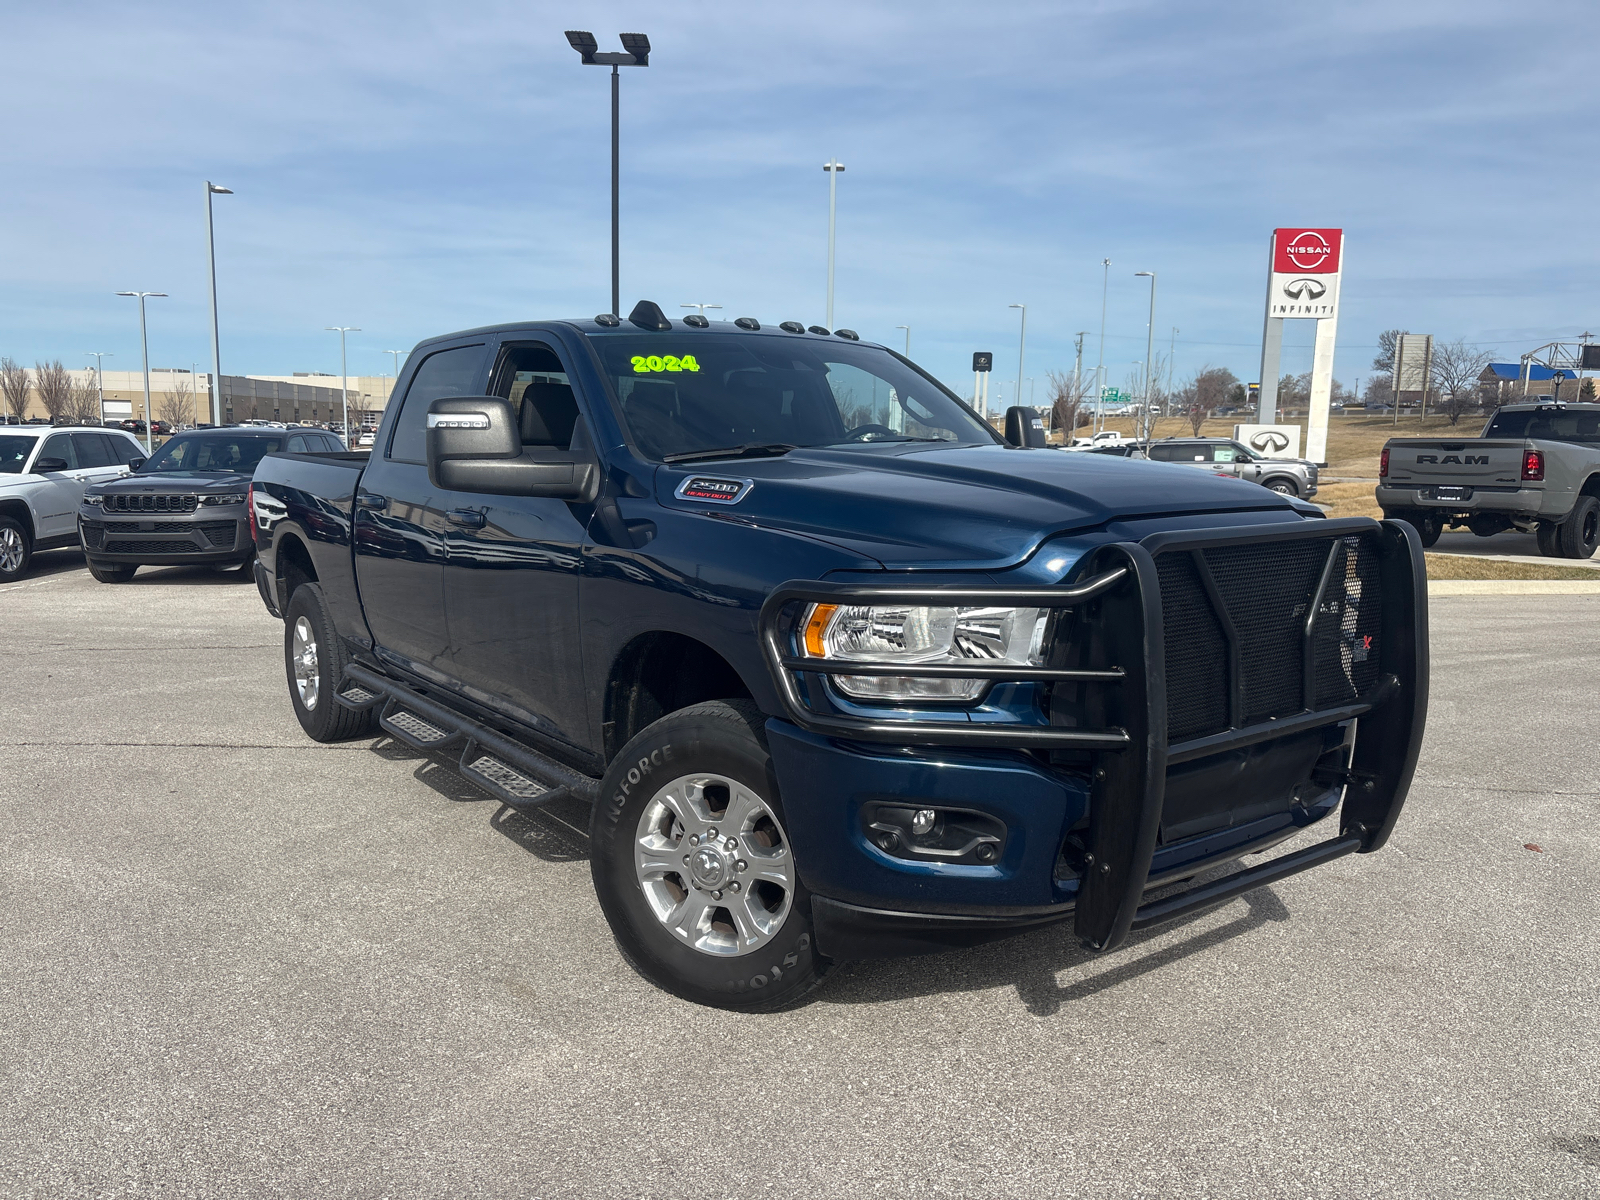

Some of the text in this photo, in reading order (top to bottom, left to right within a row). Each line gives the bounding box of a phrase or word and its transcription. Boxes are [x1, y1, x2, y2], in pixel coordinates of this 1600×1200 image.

[1286, 246, 1331, 254] NISSAN
[1272, 304, 1334, 314] INFINITI
[630, 354, 701, 373] 2024
[1416, 454, 1490, 465] RAM
[691, 480, 739, 493] 2500
[686, 490, 733, 500] HEAVY DUTY
